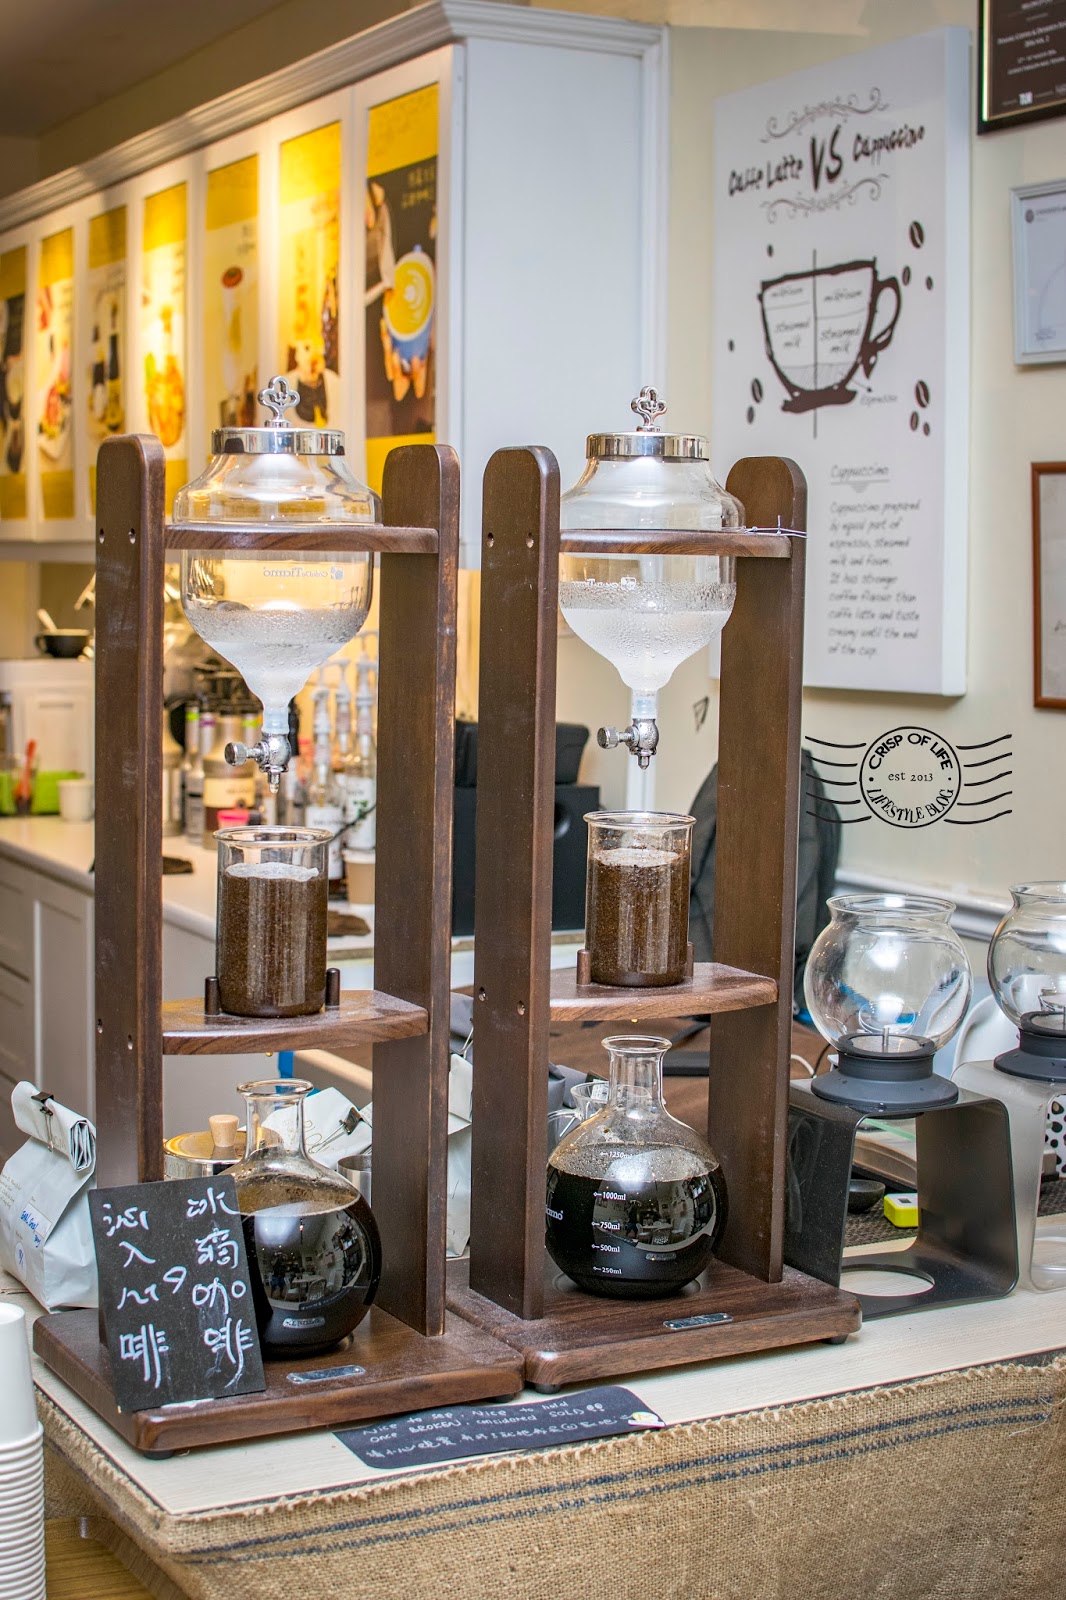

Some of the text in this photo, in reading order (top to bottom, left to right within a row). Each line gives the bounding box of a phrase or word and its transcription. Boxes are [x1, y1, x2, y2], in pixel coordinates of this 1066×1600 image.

[810, 124, 844, 192] VS
[603, 1191, 627, 1201] 1000ml
[600, 1221, 621, 1230] 750ml
[600, 1243, 621, 1253] 500ml
[602, 1266, 622, 1275] 250ml
[407, 1416, 423, 1424] to
[472, 1409, 507, 1417] Nice
